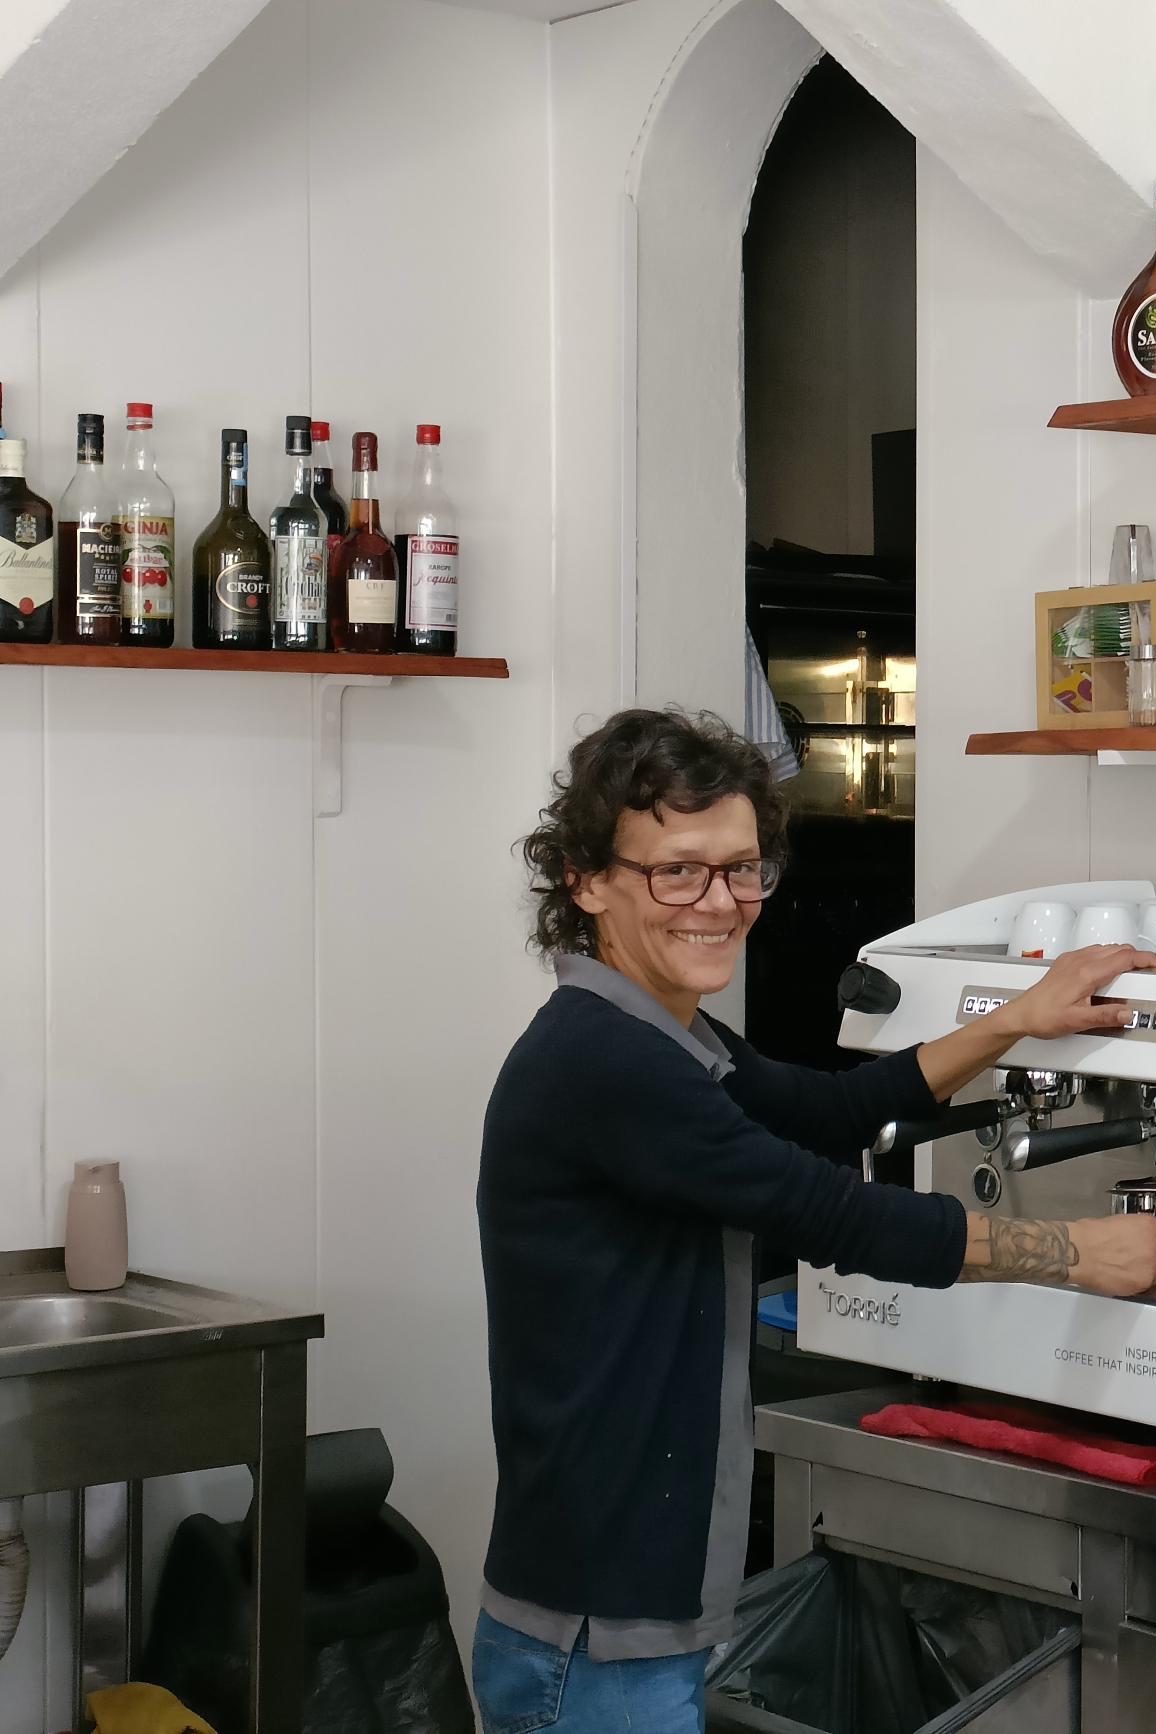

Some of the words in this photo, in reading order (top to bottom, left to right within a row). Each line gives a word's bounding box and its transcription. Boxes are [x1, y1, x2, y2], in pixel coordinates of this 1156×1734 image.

[123, 521, 169, 536] GINJA
[81, 543, 120, 554] MACIEIR
[226, 581, 271, 595] CROFT
[1054, 1348, 1093, 1367] COFFEE
[1097, 1356, 1123, 1372] THAT
